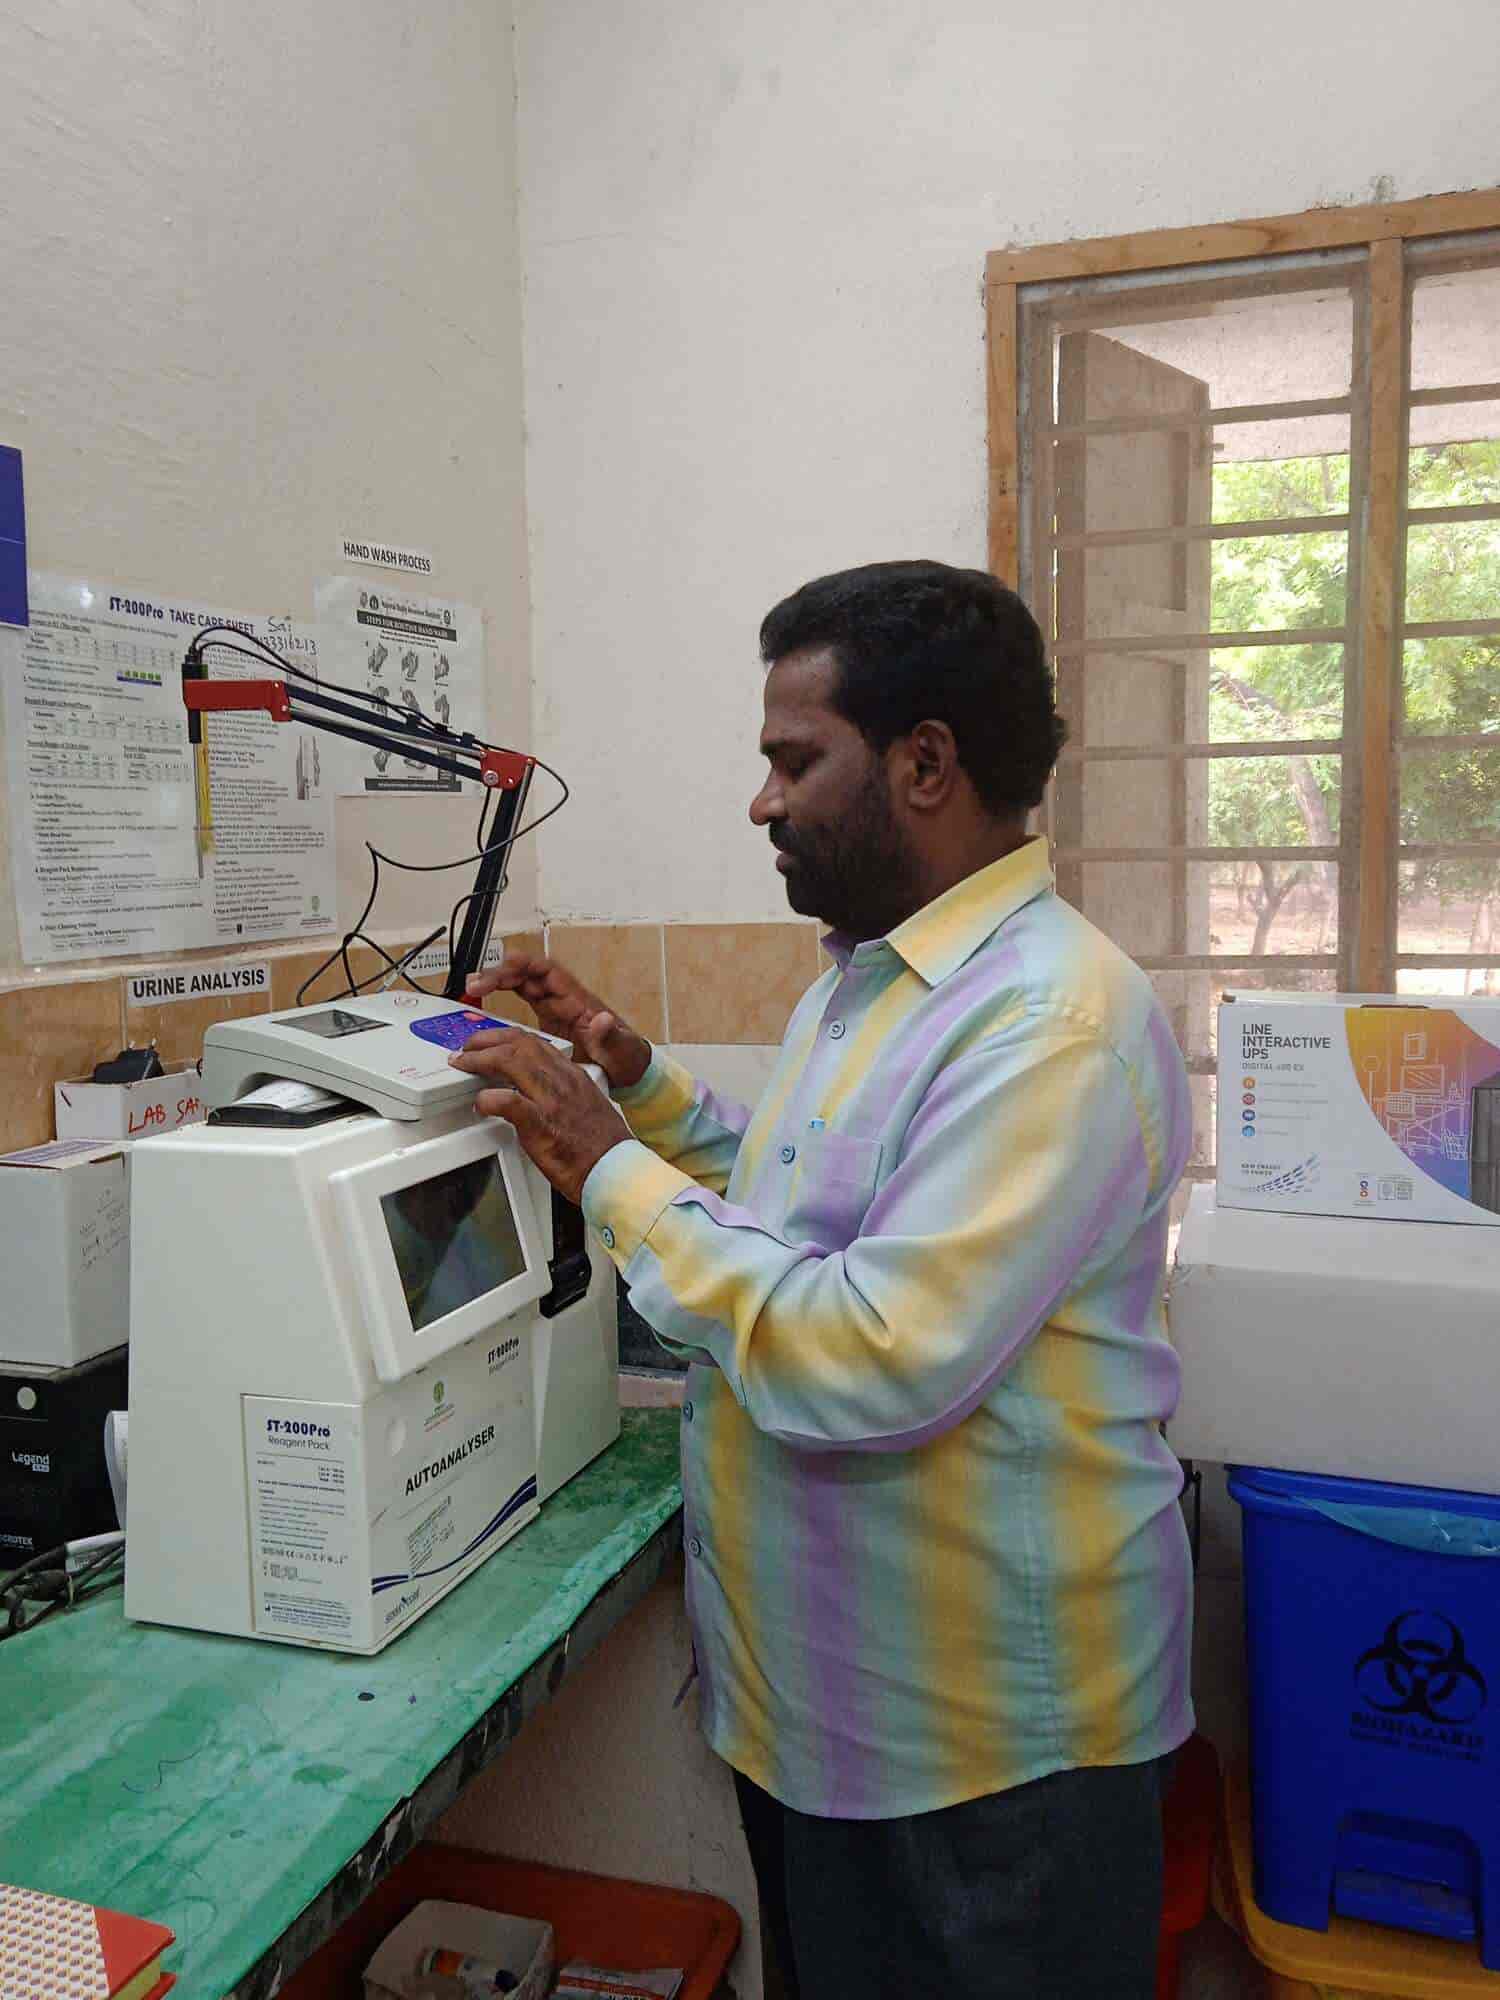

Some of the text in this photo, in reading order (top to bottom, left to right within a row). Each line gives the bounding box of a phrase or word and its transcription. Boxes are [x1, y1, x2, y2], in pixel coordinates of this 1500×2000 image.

[344, 540, 431, 572] HAND WASH PROCESS
[169, 609, 196, 625] TAKE
[133, 969, 265, 998] URINE ANALYSIS
[1242, 1023, 1272, 1035] LINE
[1242, 1036, 1331, 1048] INTERACTIVE
[1242, 1048, 1269, 1060] UPS
[128, 1103, 166, 1133] LAB
[267, 1419, 330, 1437] ST-200Pro
[268, 1435, 330, 1450] Reagent Pack
[405, 1424, 496, 1496] AUTOANALYSER
